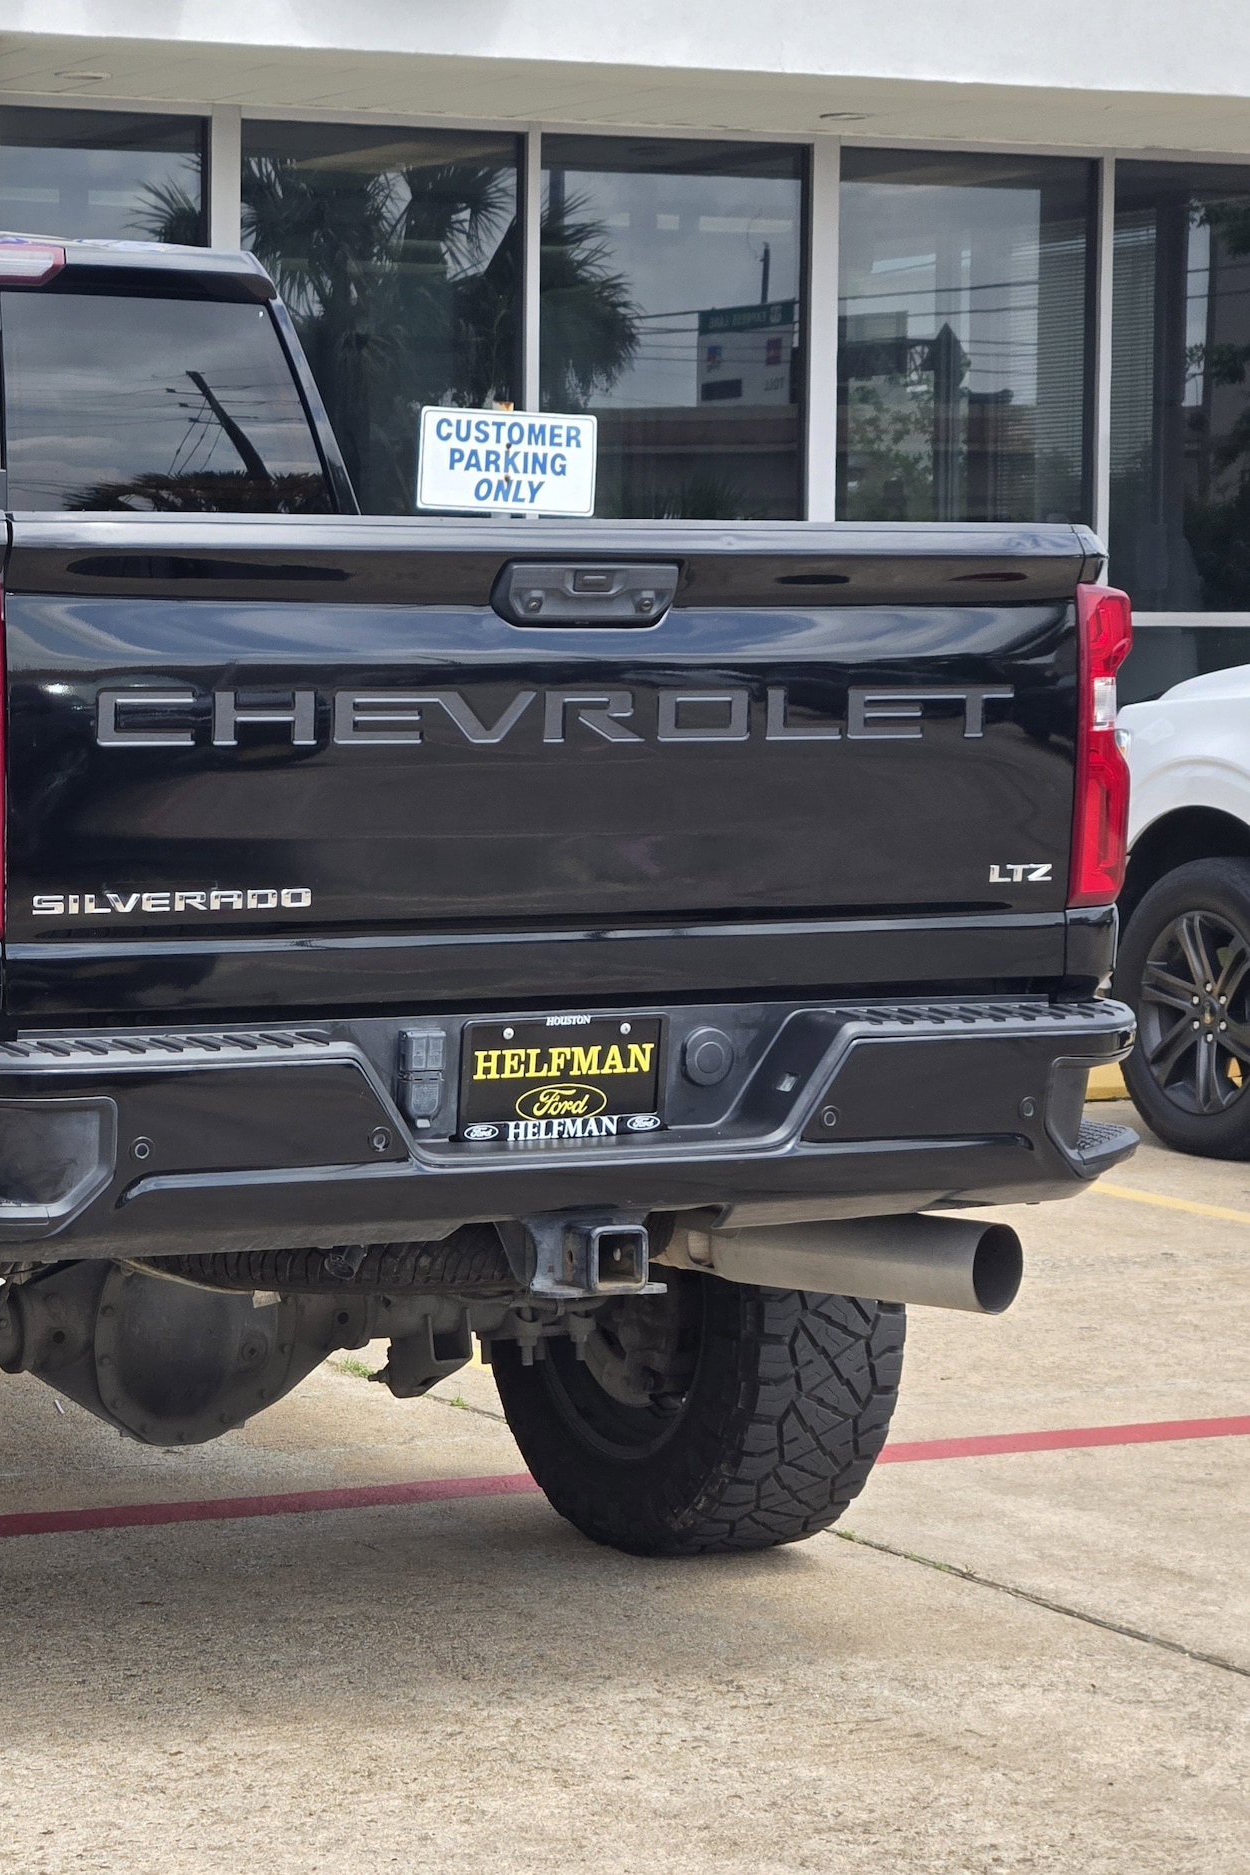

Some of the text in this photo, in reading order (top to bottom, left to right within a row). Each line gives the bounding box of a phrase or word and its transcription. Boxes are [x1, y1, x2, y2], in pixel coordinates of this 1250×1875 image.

[436, 417, 581, 447] CUSTOMER
[448, 448, 566, 476] PARKING
[474, 478, 545, 503] ONLY
[95, 686, 1014, 747] CHEVROLET
[988, 863, 1052, 882] LTZ
[32, 887, 311, 915] SILVERADO
[545, 1014, 590, 1026] HOUSTON
[472, 1043, 654, 1079] HELFMAN
[532, 1088, 589, 1117] Ford
[469, 1115, 655, 1141] Ford HELFMAN Ford
